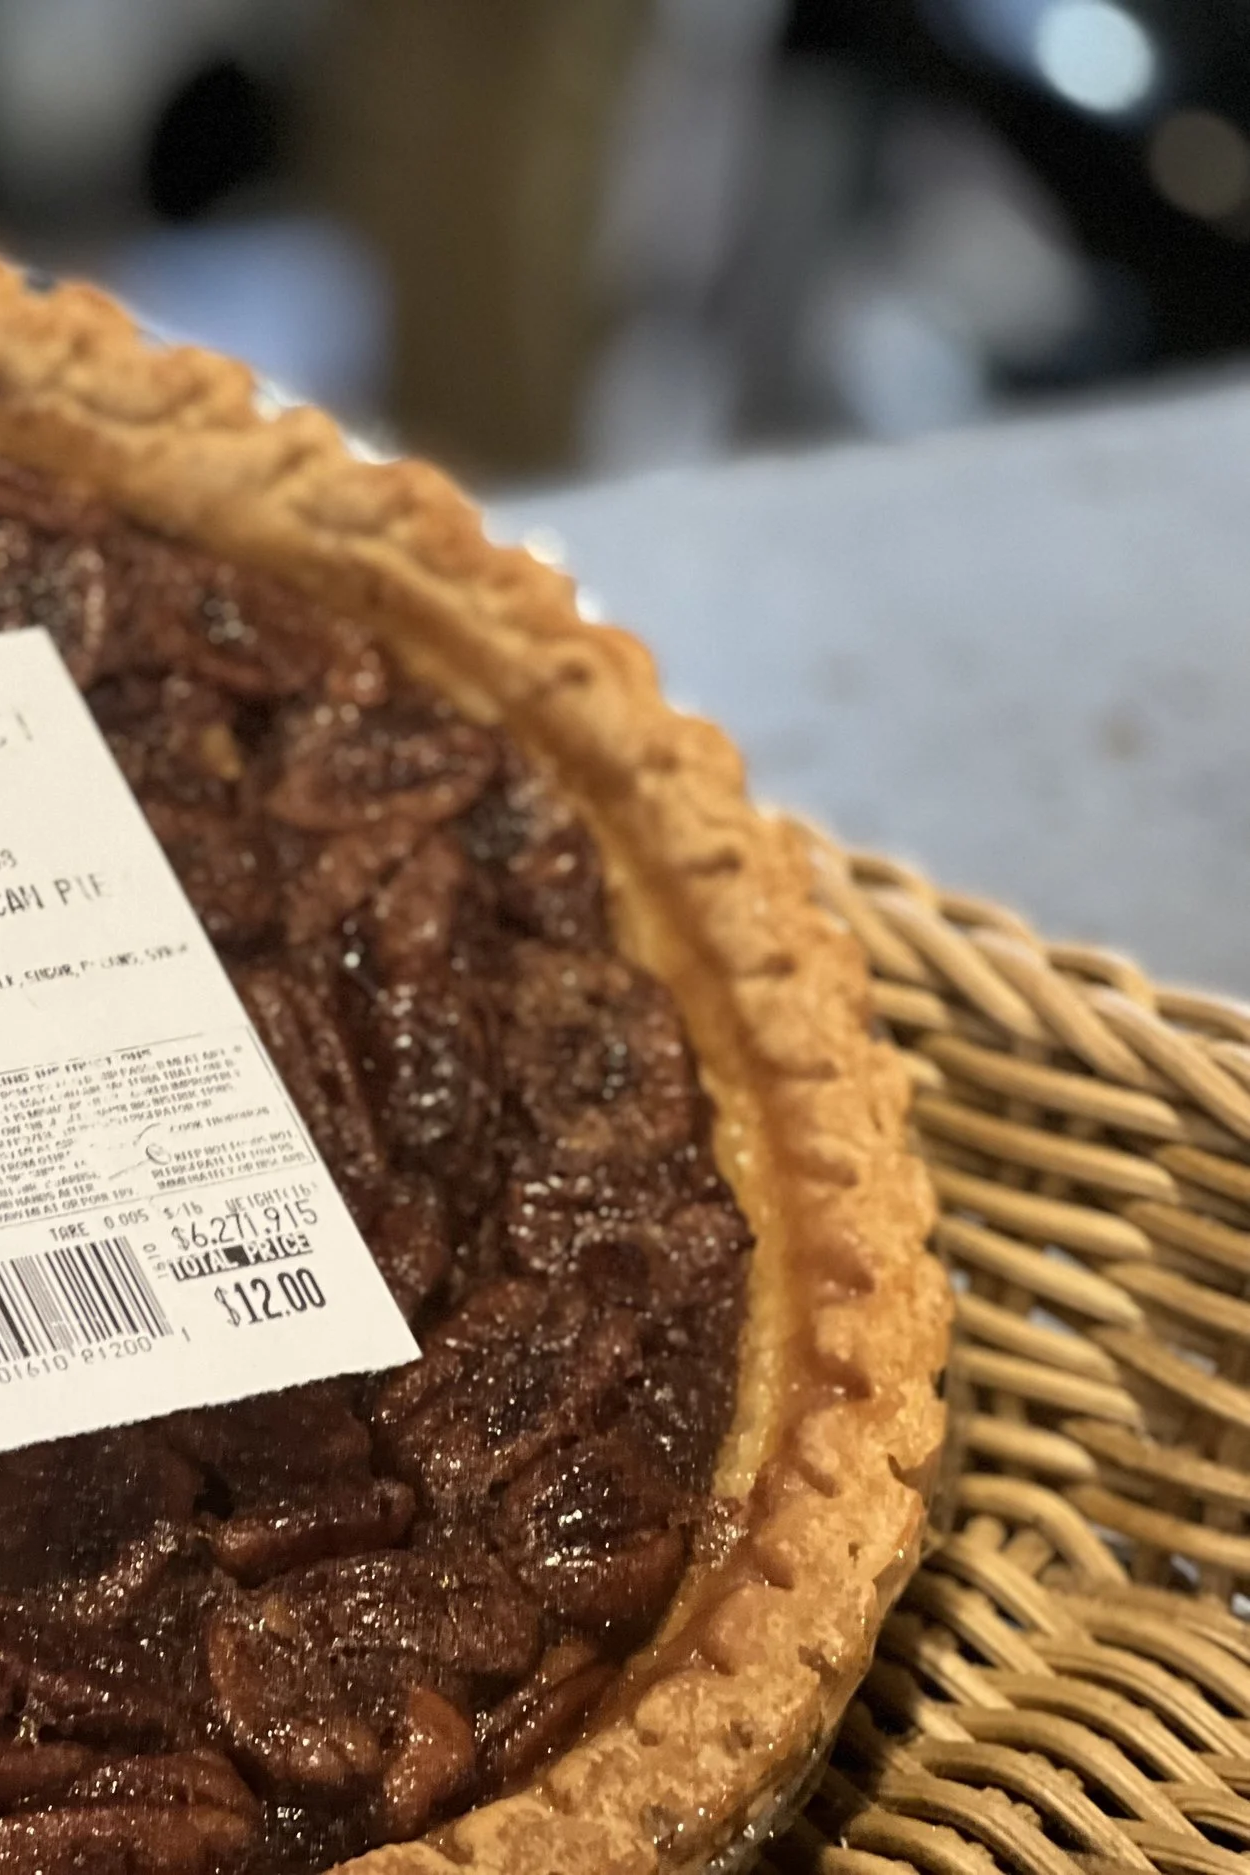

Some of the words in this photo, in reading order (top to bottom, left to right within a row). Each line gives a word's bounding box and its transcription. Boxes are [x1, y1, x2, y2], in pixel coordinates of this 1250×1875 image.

[53, 873, 111, 905] PIE
[49, 1222, 90, 1242] TARE
[103, 1208, 149, 1230] 0005
[168, 1247, 239, 1282] TOTAL
[247, 1232, 313, 1267] PRICE
[214, 1267, 326, 1327] $12.00
